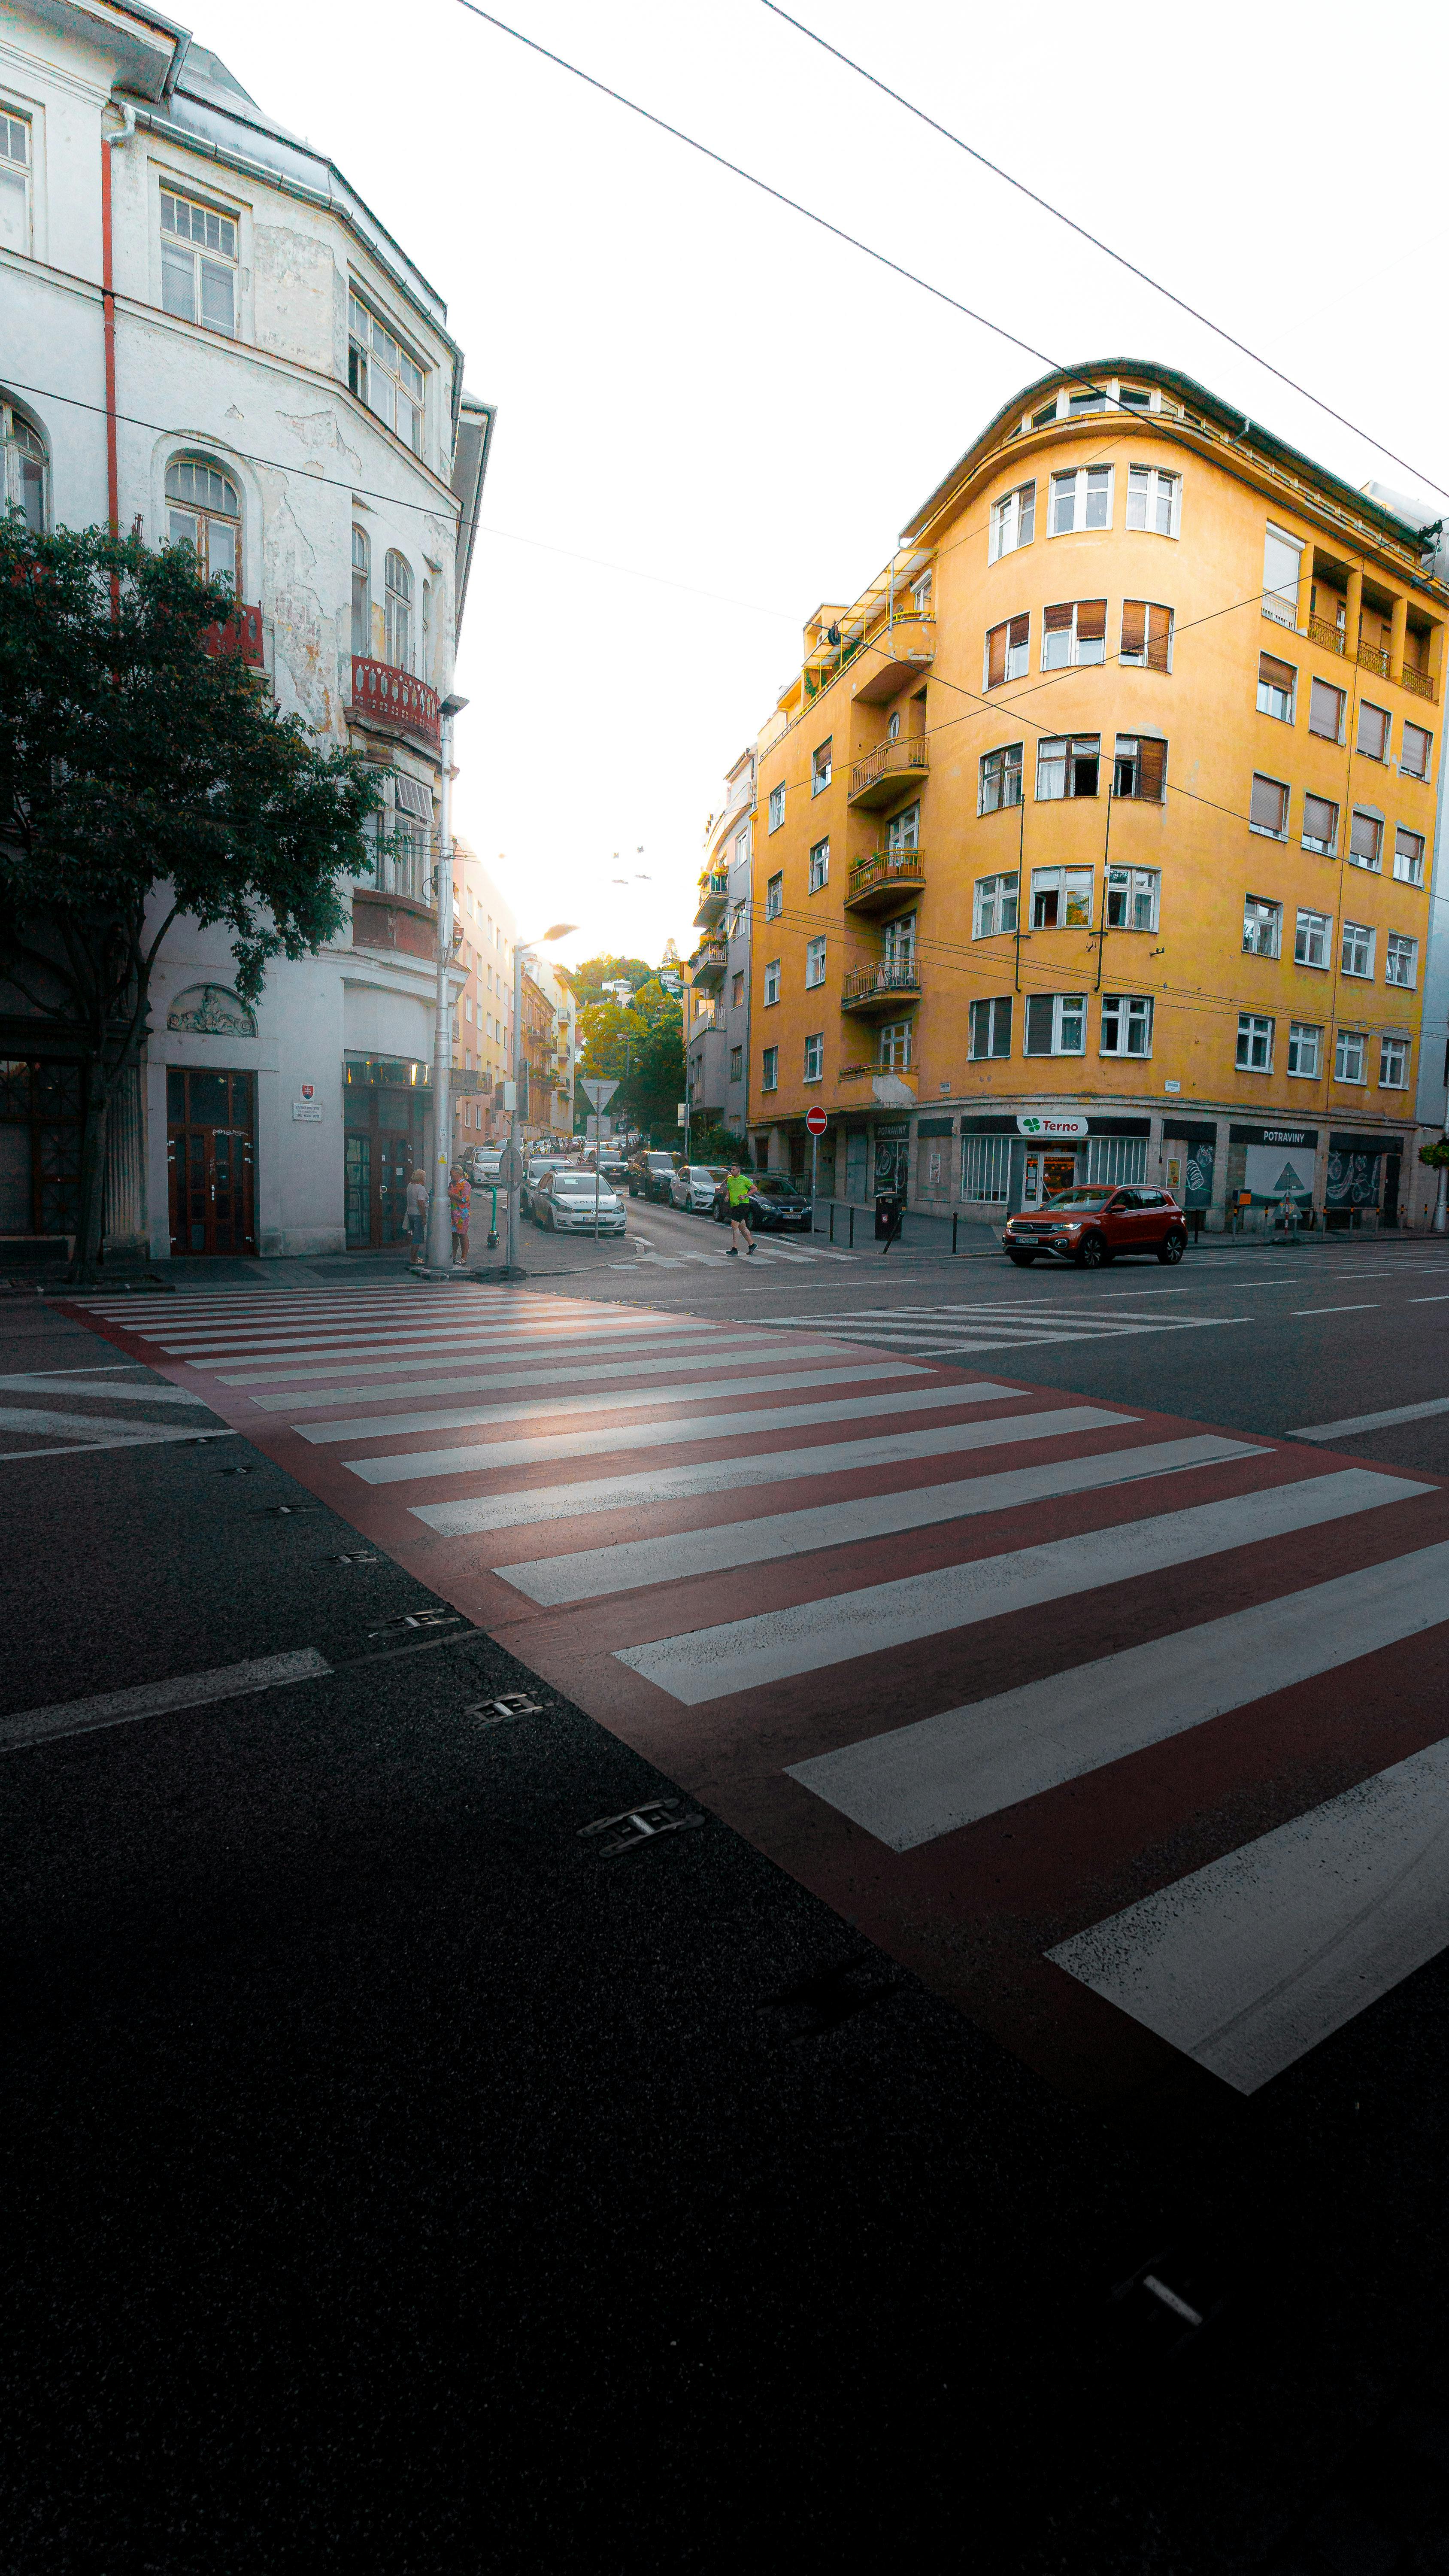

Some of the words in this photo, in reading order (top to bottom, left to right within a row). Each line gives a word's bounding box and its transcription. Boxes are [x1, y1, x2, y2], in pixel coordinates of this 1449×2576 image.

[878, 1125, 906, 1136] POTRAVINY
[1043, 1120, 1078, 1131] Terno
[1264, 1131, 1304, 1142] POTRAVINY
